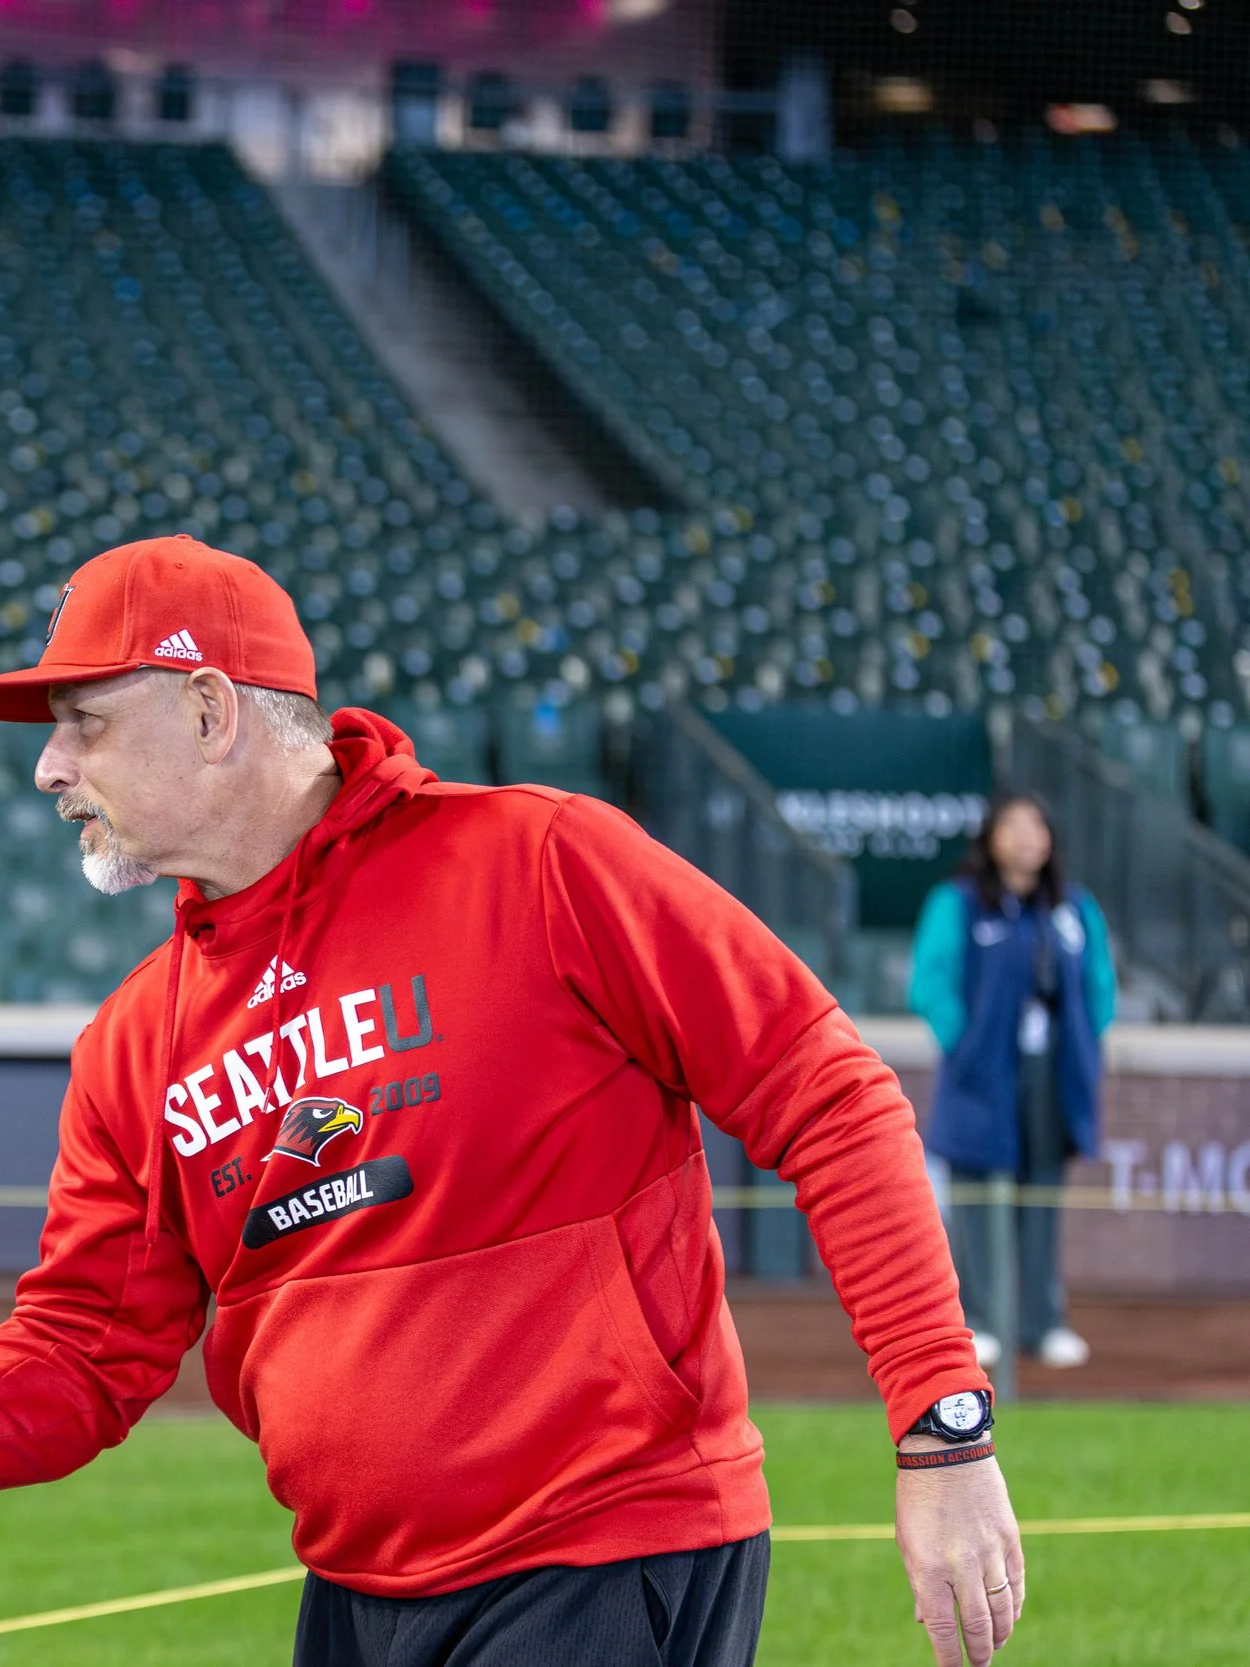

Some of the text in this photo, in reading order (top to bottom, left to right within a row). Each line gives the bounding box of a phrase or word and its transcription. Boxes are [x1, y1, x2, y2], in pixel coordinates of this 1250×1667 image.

[154, 645, 203, 662] adidas
[247, 972, 307, 1009] adias
[369, 1073, 440, 1116] 2009
[211, 1156, 253, 1198] EST.
[267, 1170, 374, 1231] BASEBALL
